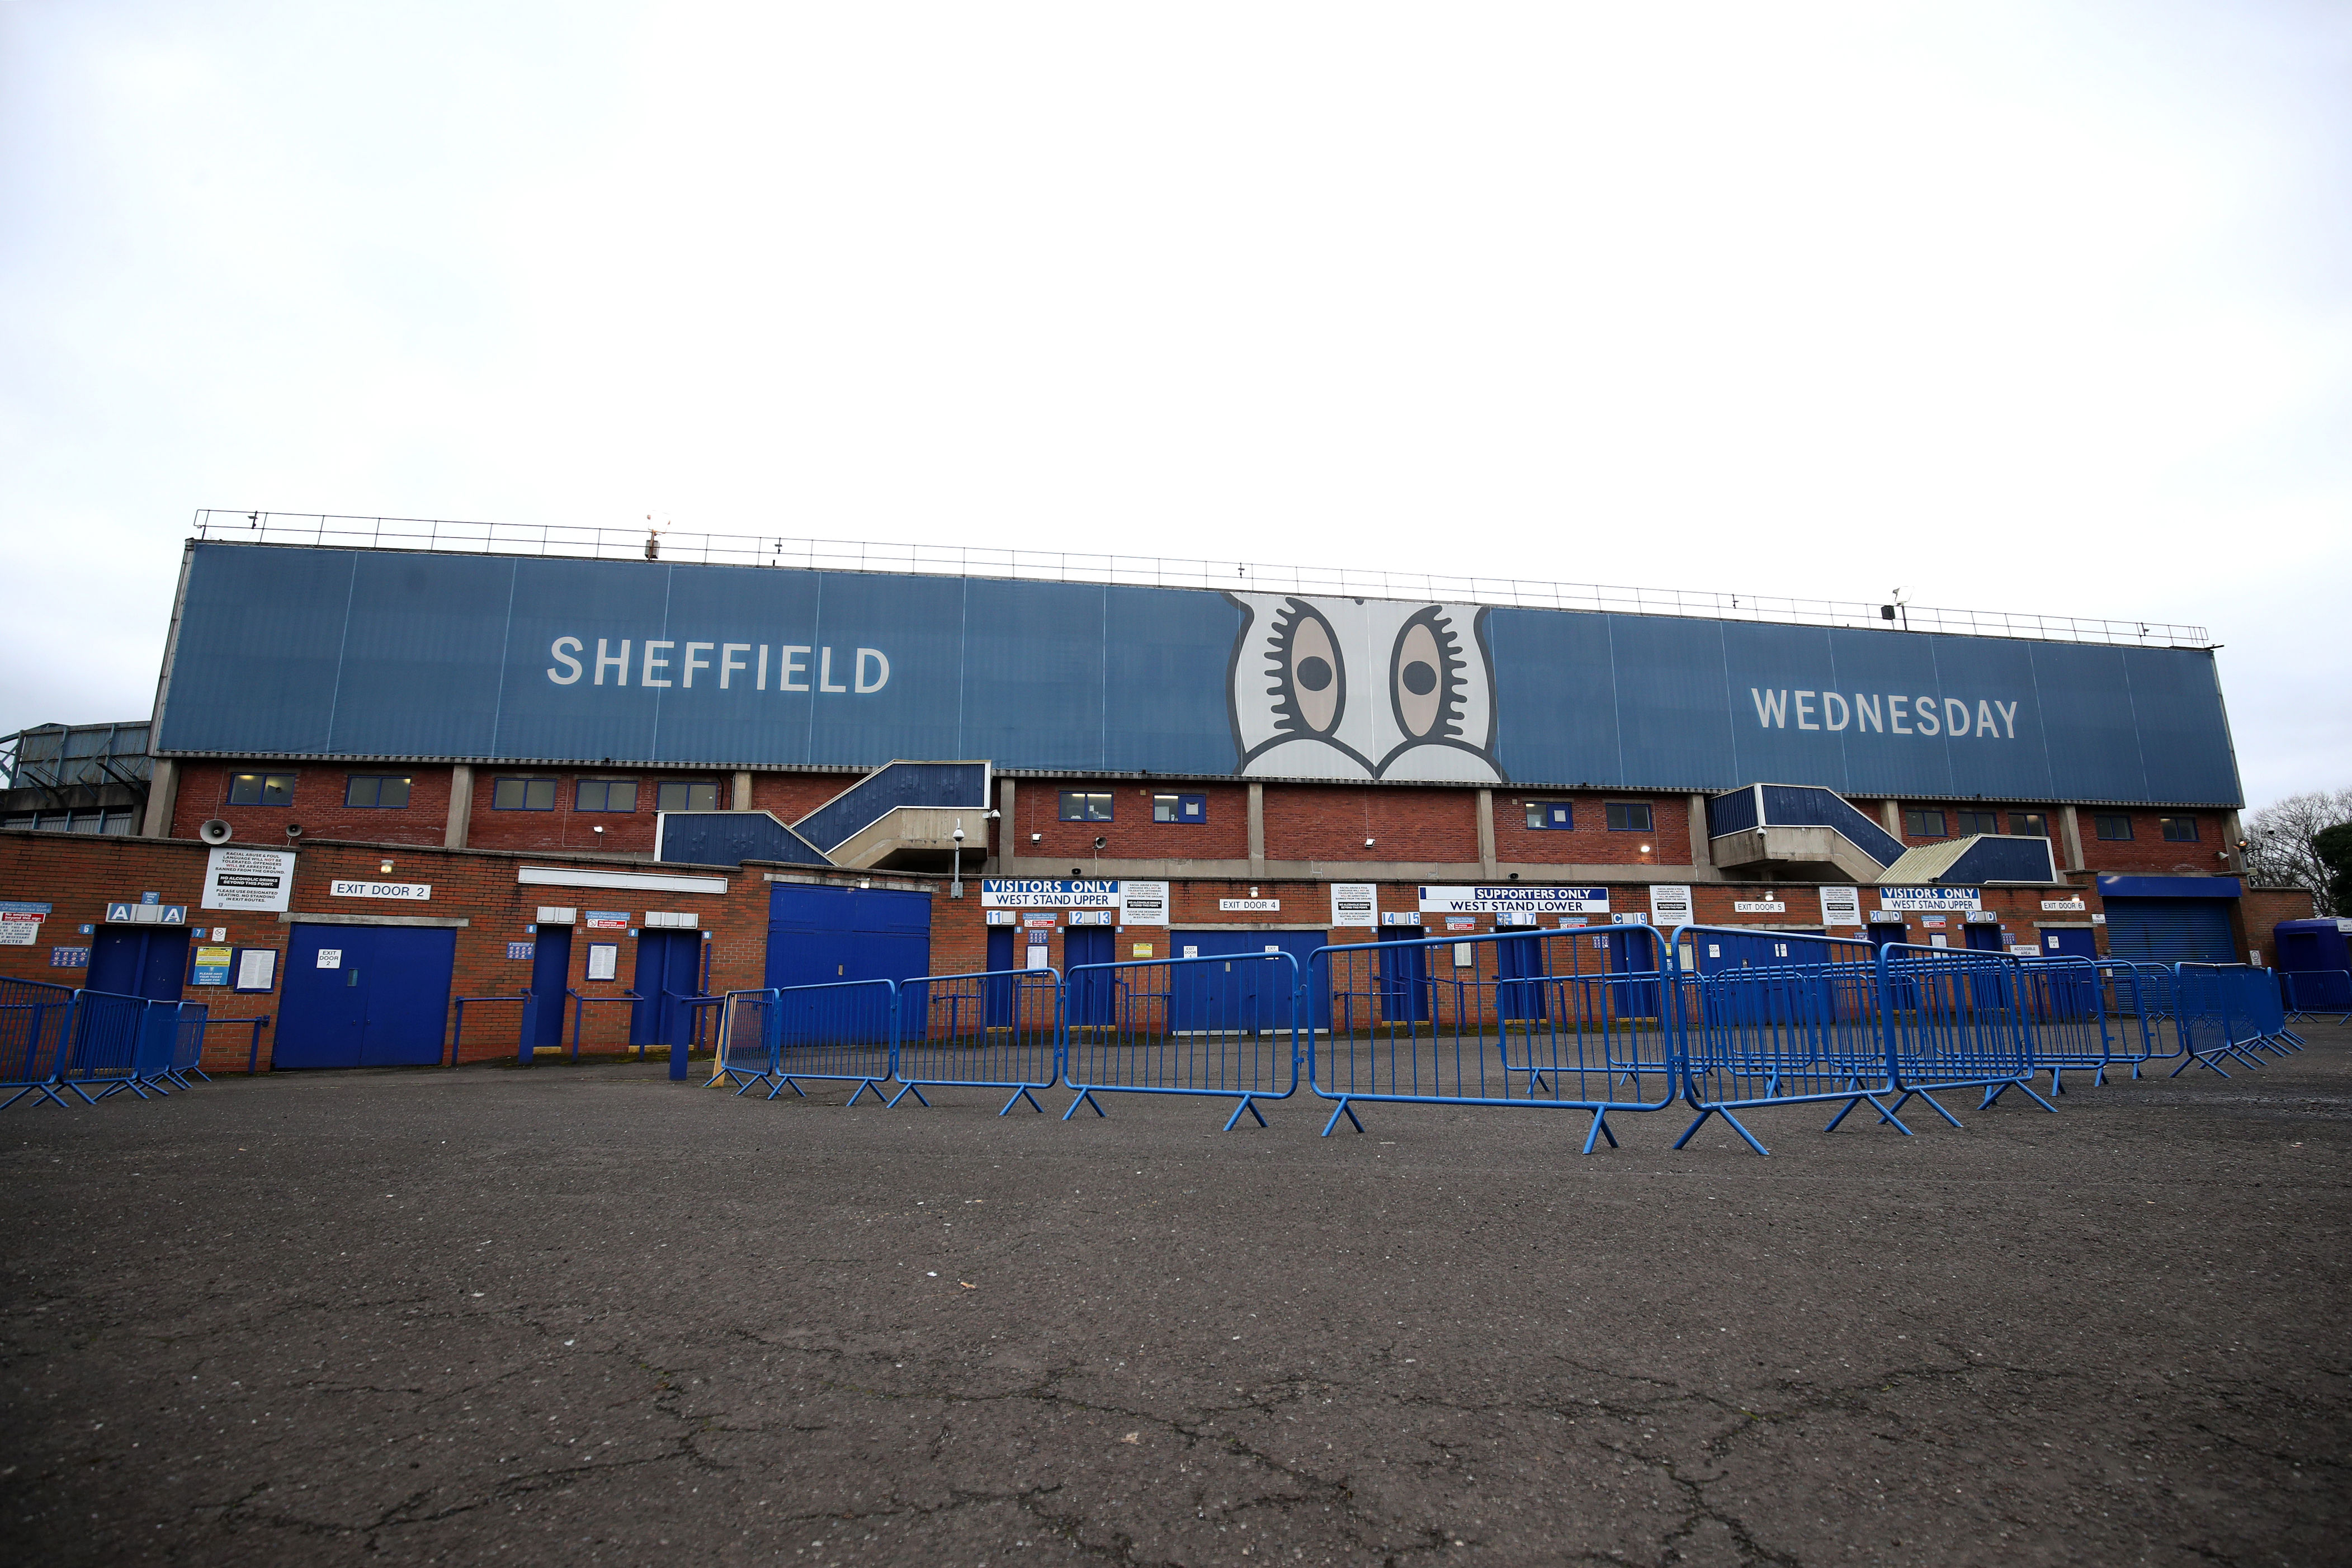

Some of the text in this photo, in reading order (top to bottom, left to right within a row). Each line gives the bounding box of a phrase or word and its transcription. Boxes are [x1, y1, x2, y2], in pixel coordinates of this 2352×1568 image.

[546, 636, 890, 693] SHEFFIELD
[1751, 688, 2018, 738] WEDNESDAY
[337, 884, 424, 896] EXIT DOOR 2
[989, 881, 1112, 892] VISITORS ONLY
[996, 895, 1108, 904] WEST STAND UPPER
[1477, 889, 1590, 899] SUPPORTERS ONLY
[1885, 889, 1974, 899] VISITORS ONLY
[1450, 901, 1583, 910] WEST STAND LOWER
[1919, 900, 1946, 909] STAND
[1949, 900, 1973, 909] UPPER
[112, 906, 129, 920] A
[164, 909, 180, 922] A
[988, 911, 1001, 923] 11
[1070, 912, 1082, 924] 12
[1098, 912, 1110, 924] 13
[1383, 913, 1394, 924] 14
[1408, 913, 1419, 924] 15
[1524, 913, 1534, 924] 17
[1613, 914, 1622, 923] C
[1636, 913, 1646, 924] 19
[1893, 912, 1900, 921] D
[1967, 912, 1976, 922] 22
[1988, 912, 1994, 920] D
